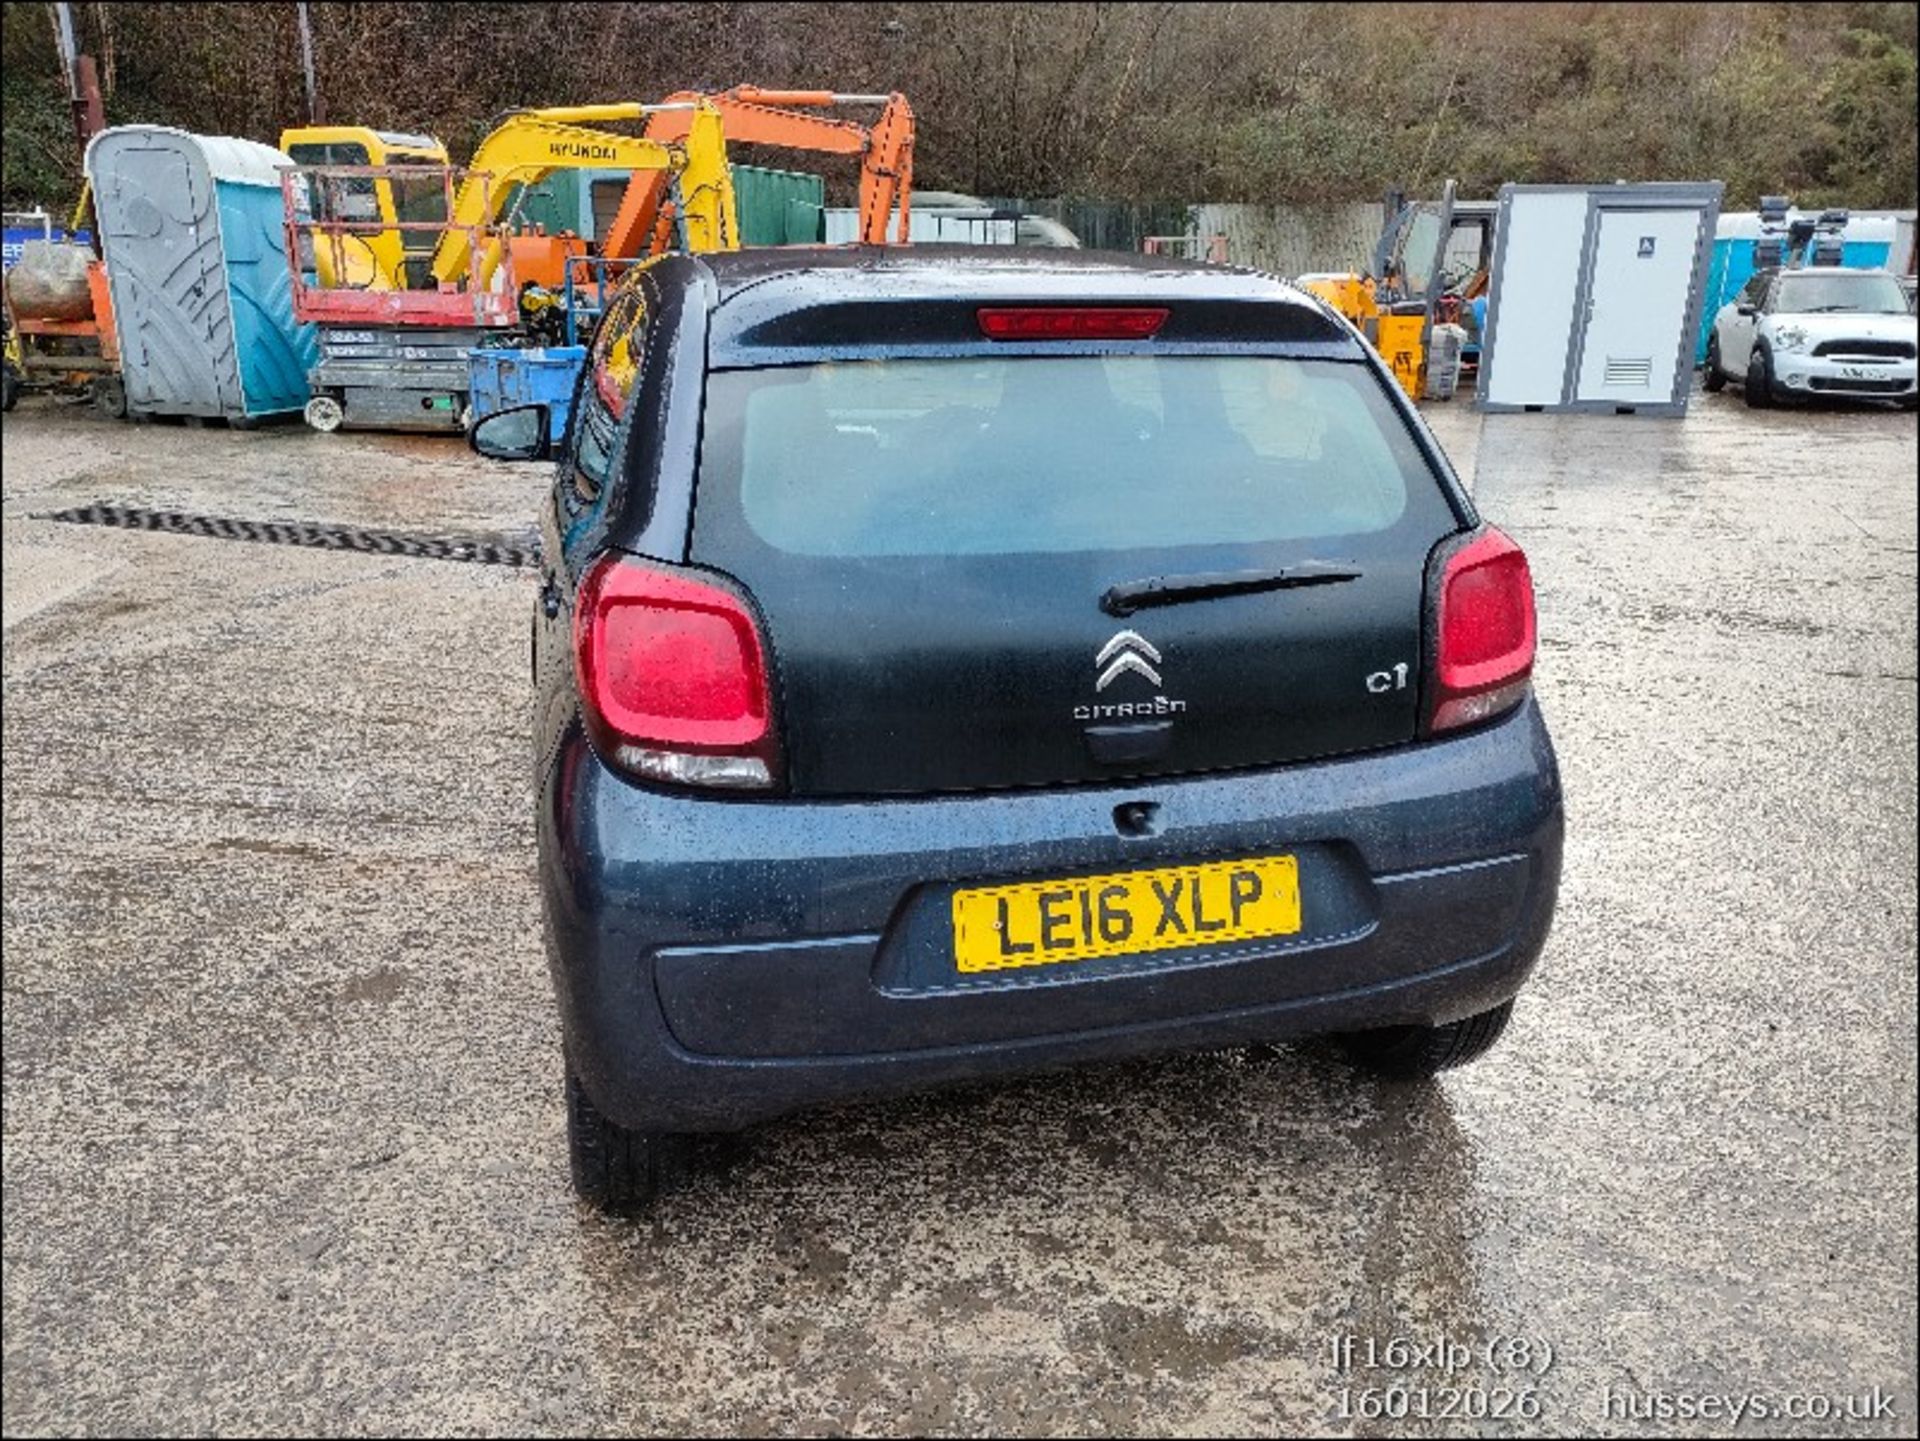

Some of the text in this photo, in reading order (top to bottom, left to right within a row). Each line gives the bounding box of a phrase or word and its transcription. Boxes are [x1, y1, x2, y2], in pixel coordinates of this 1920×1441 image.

[549, 143, 617, 161] HYUNDAI
[998, 870, 1262, 956] LE16 XLP
